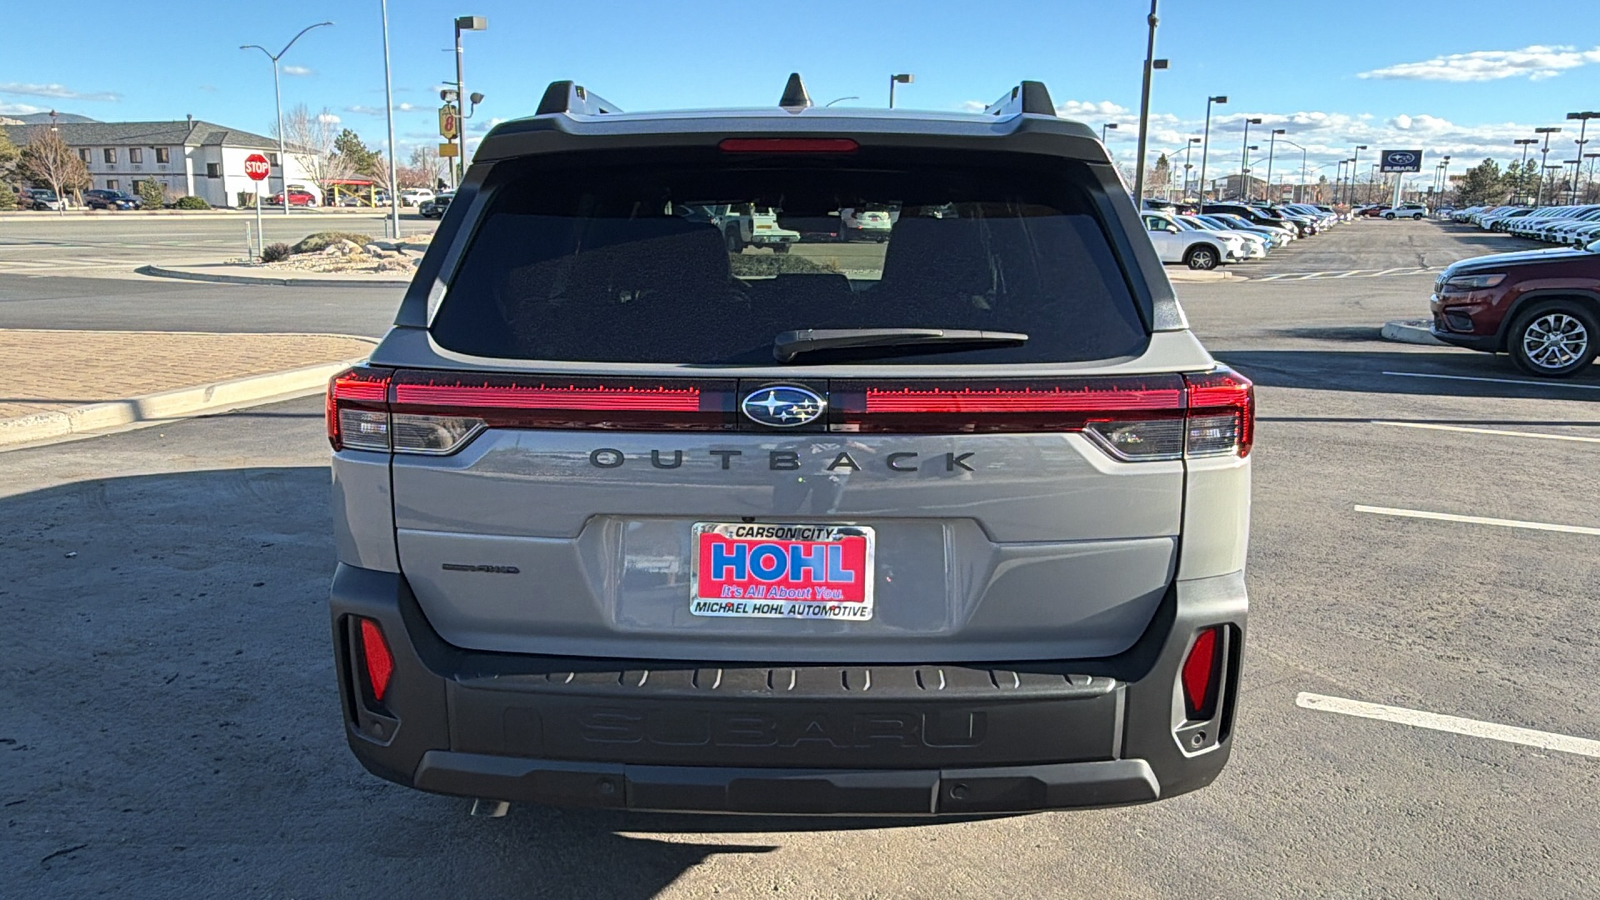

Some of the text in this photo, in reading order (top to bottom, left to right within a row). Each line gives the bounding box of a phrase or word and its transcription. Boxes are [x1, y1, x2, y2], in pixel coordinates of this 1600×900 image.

[444, 115, 454, 132] 8
[245, 161, 269, 173] STOP
[589, 448, 976, 472] OUTBACK
[735, 526, 835, 540] CARSON CITY
[712, 543, 854, 582] HOHL
[721, 584, 742, 597] It's
[745, 585, 765, 598] All
[768, 586, 811, 598] About
[694, 602, 868, 617] MICHAEL HOHL AUTOMOTIVE
[580, 711, 988, 749] SUBARU
